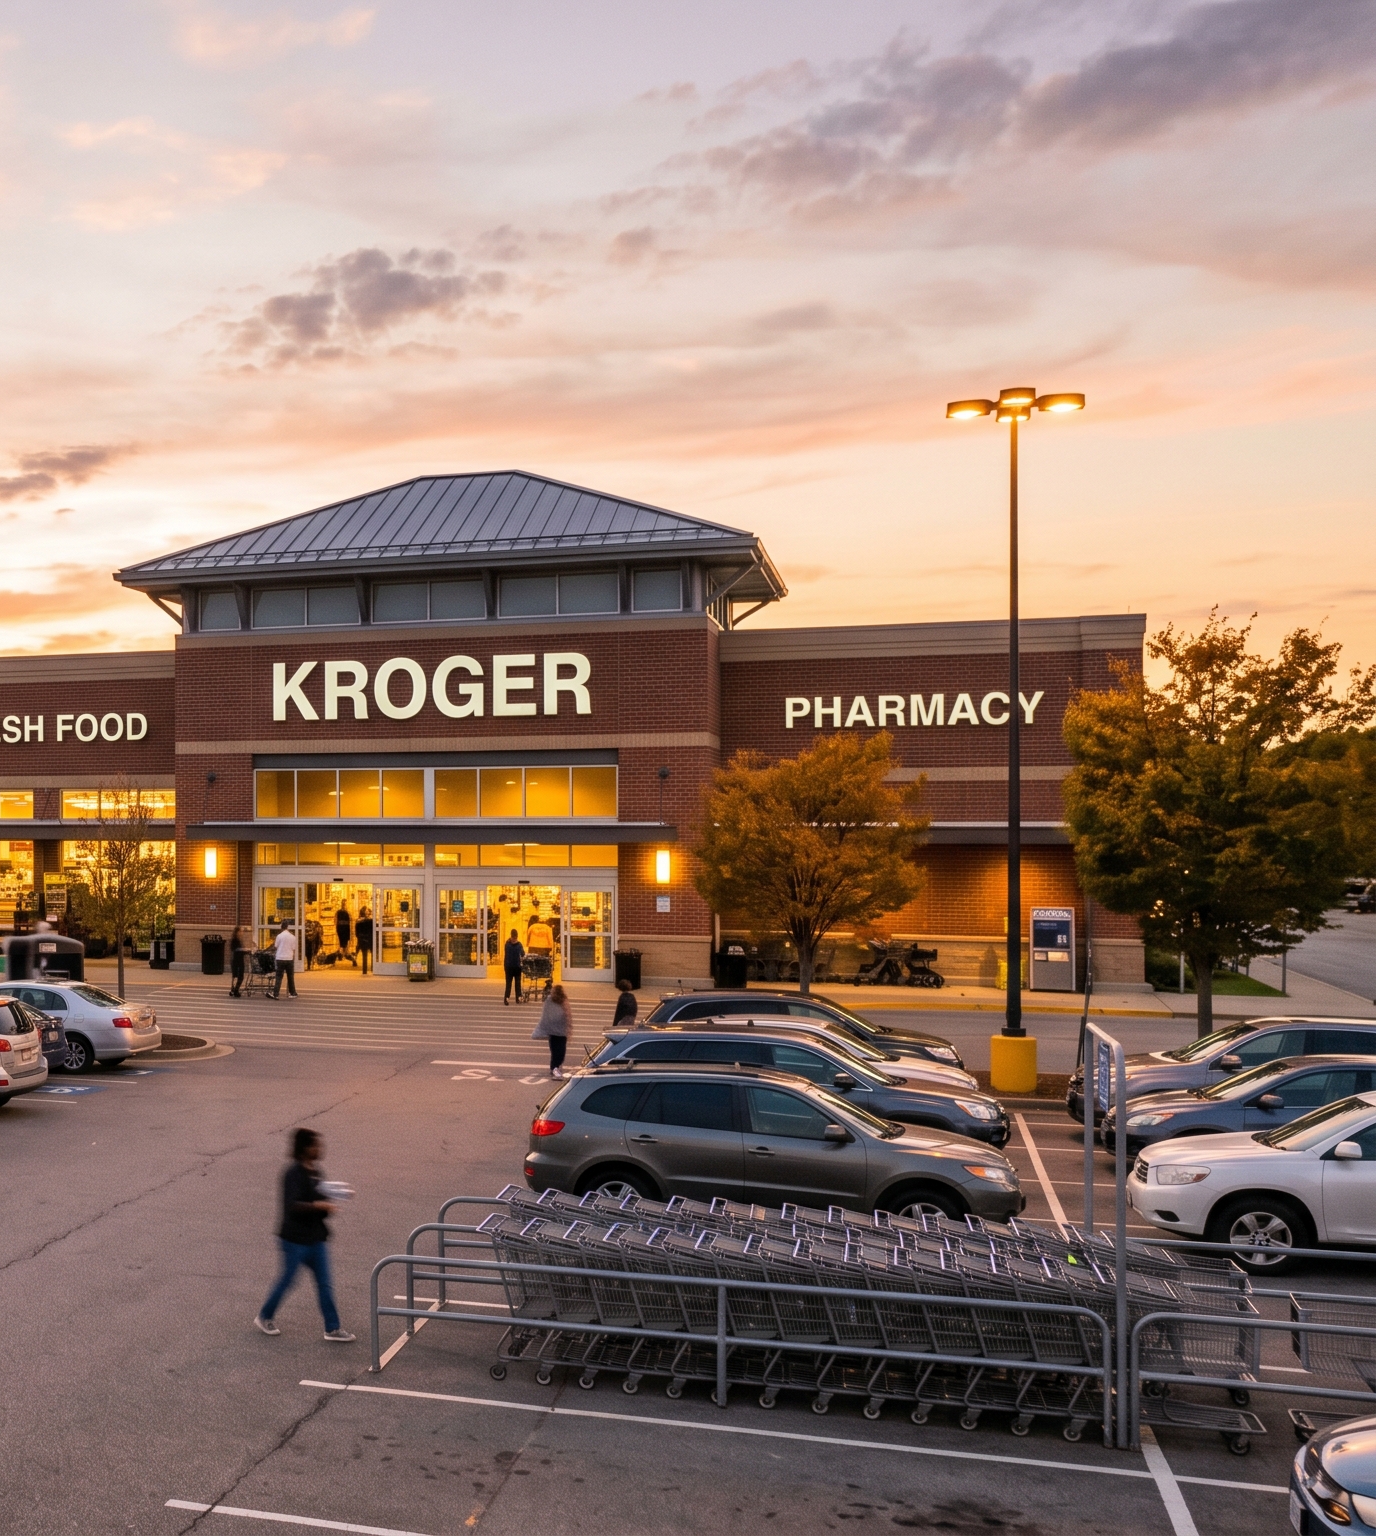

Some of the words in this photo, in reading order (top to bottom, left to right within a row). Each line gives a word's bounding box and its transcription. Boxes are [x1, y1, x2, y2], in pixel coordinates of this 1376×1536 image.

[273, 652, 591, 721] KROGER
[56, 713, 148, 742] FOOD
[785, 691, 1045, 728] PHARMACY
